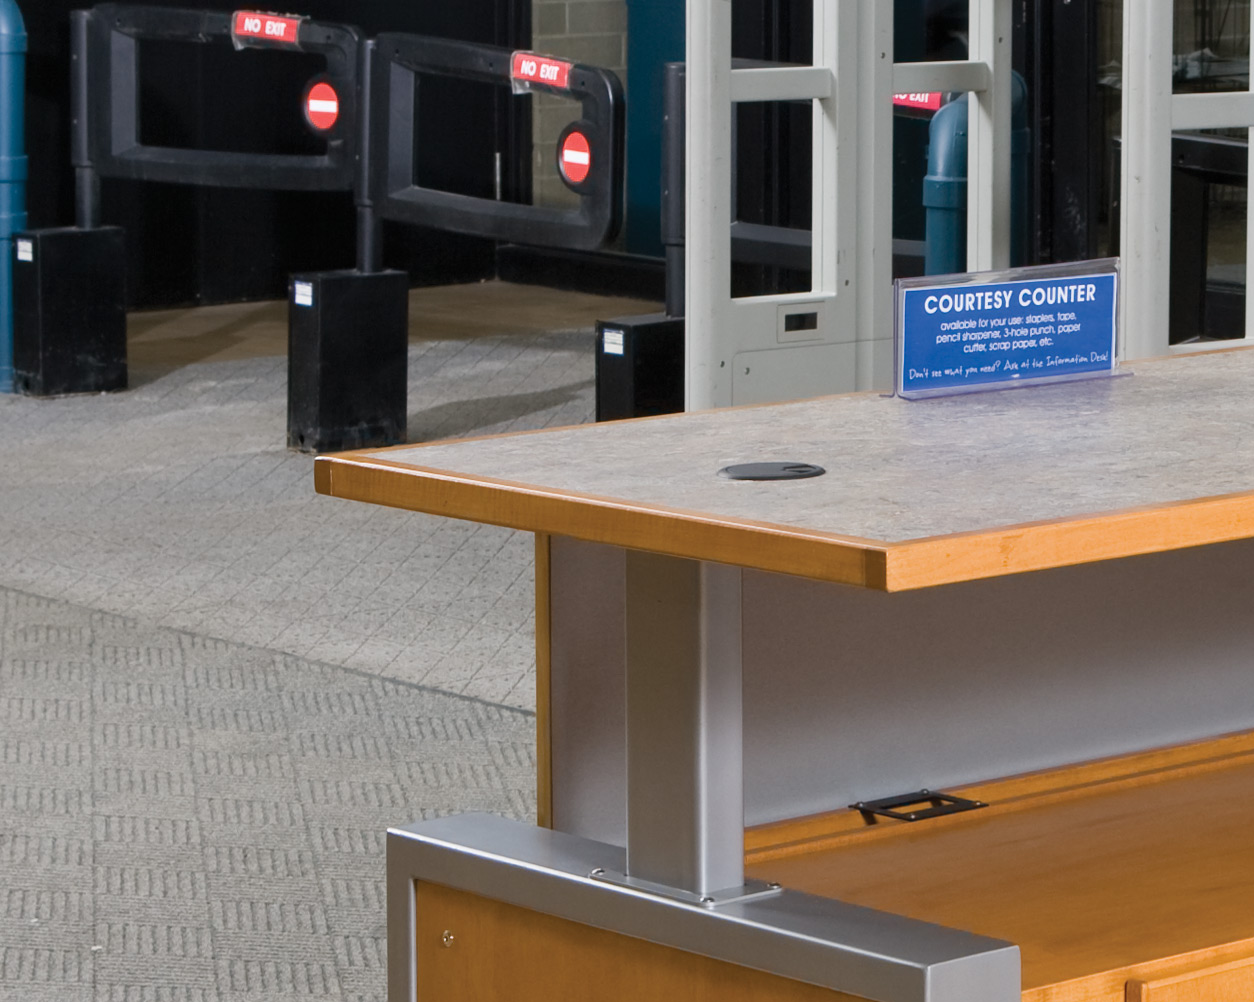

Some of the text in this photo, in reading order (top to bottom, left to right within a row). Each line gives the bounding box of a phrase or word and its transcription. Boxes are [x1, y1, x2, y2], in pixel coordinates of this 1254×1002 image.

[244, 17, 286, 36] NO EXIT
[520, 60, 559, 80] NO EXIT
[924, 283, 1096, 314] COURTESY COUNTER
[940, 319, 976, 331] available
[978, 318, 988, 328] for
[990, 317, 1006, 328] your
[1008, 315, 1024, 325] use:
[1057, 311, 1077, 322] tape,
[936, 323, 1081, 344] pencil sharpener, 3-hole punch, paper
[963, 336, 1054, 353] cutter, scrap paper, etc.
[909, 350, 1109, 380] Don't see what you need? Ask at the Information Desk!
